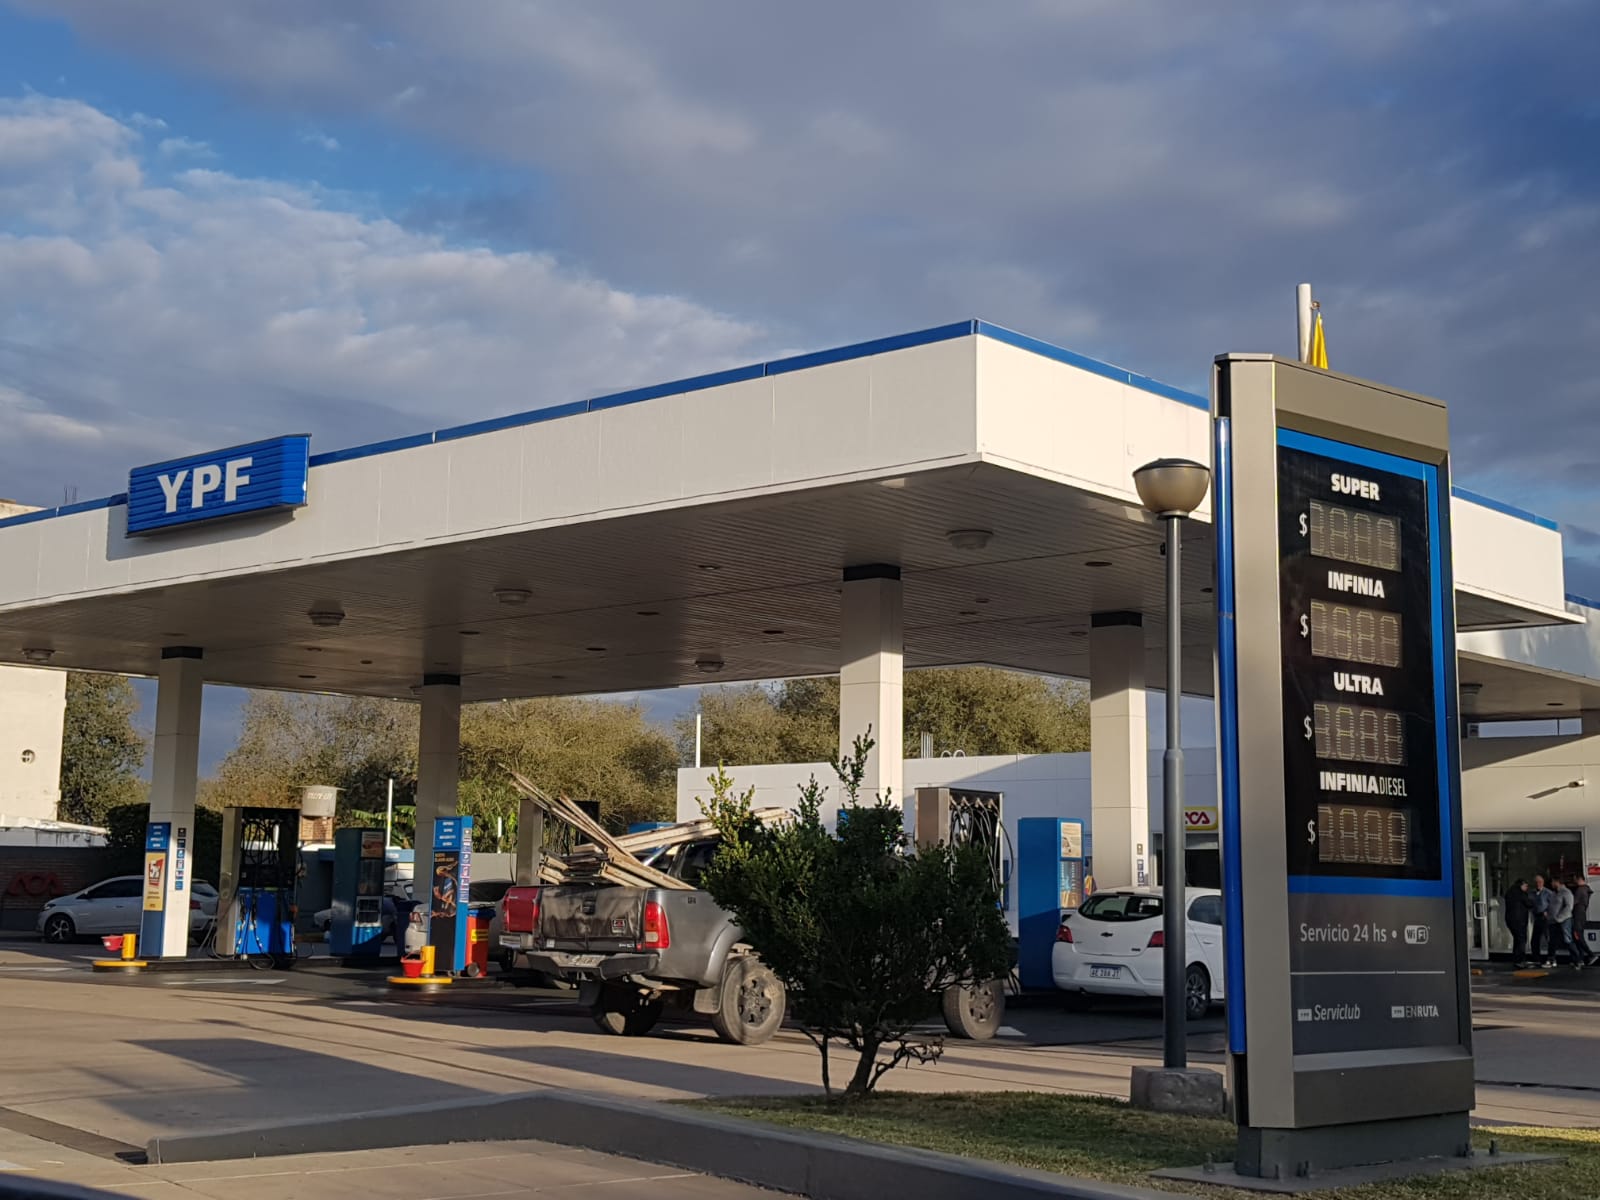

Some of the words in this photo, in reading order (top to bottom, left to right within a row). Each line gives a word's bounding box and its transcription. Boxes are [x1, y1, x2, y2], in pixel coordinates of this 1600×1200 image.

[157, 457, 253, 513] YPF
[1330, 473, 1380, 501] SUPER
[1298, 513, 1308, 537] $
[1327, 570, 1385, 599] INFINIA
[1300, 614, 1309, 638] $
[1333, 671, 1384, 696] ULTRA
[1303, 716, 1313, 740] $
[1307, 819, 1316, 845] $
[1300, 923, 1350, 943] Servicio
[1353, 924, 1369, 942] 24
[1372, 922, 1387, 942] hs
[1314, 1004, 1361, 1021] Serviclub
